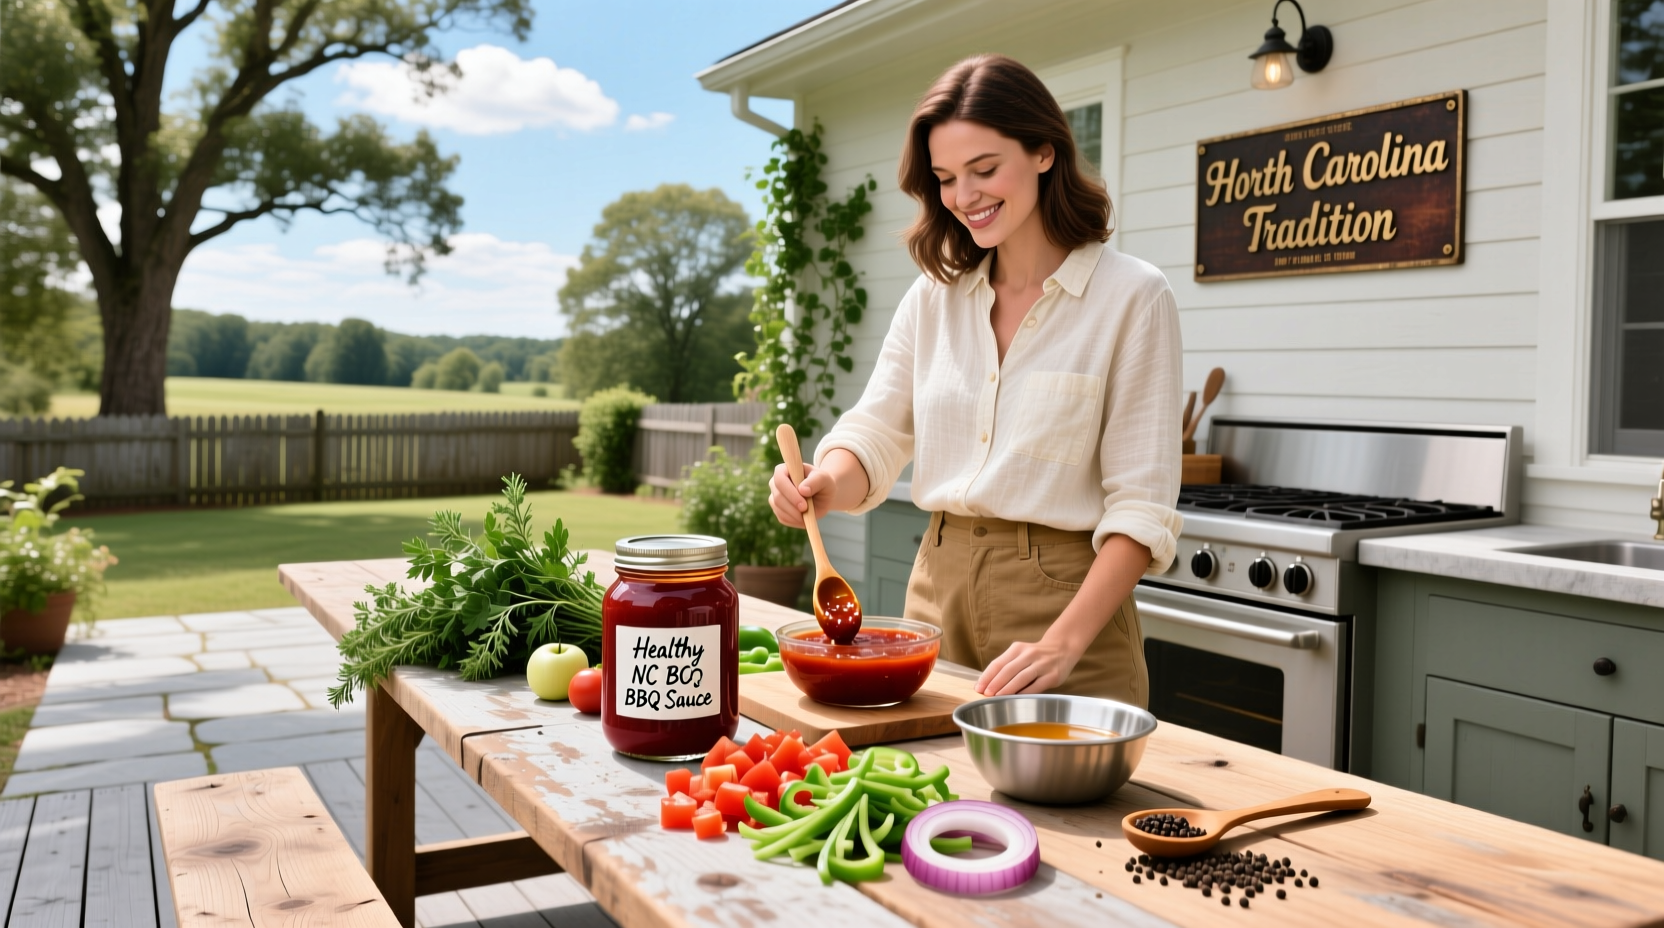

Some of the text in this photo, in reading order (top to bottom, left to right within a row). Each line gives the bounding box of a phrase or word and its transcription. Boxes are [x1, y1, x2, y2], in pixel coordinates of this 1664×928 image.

[1302, 132, 1448, 190] Carolina
[1243, 200, 1396, 252] Tradition
[632, 636, 704, 667] Healthy
[632, 664, 659, 685] NC
[625, 688, 712, 711] BBQ Sauce
